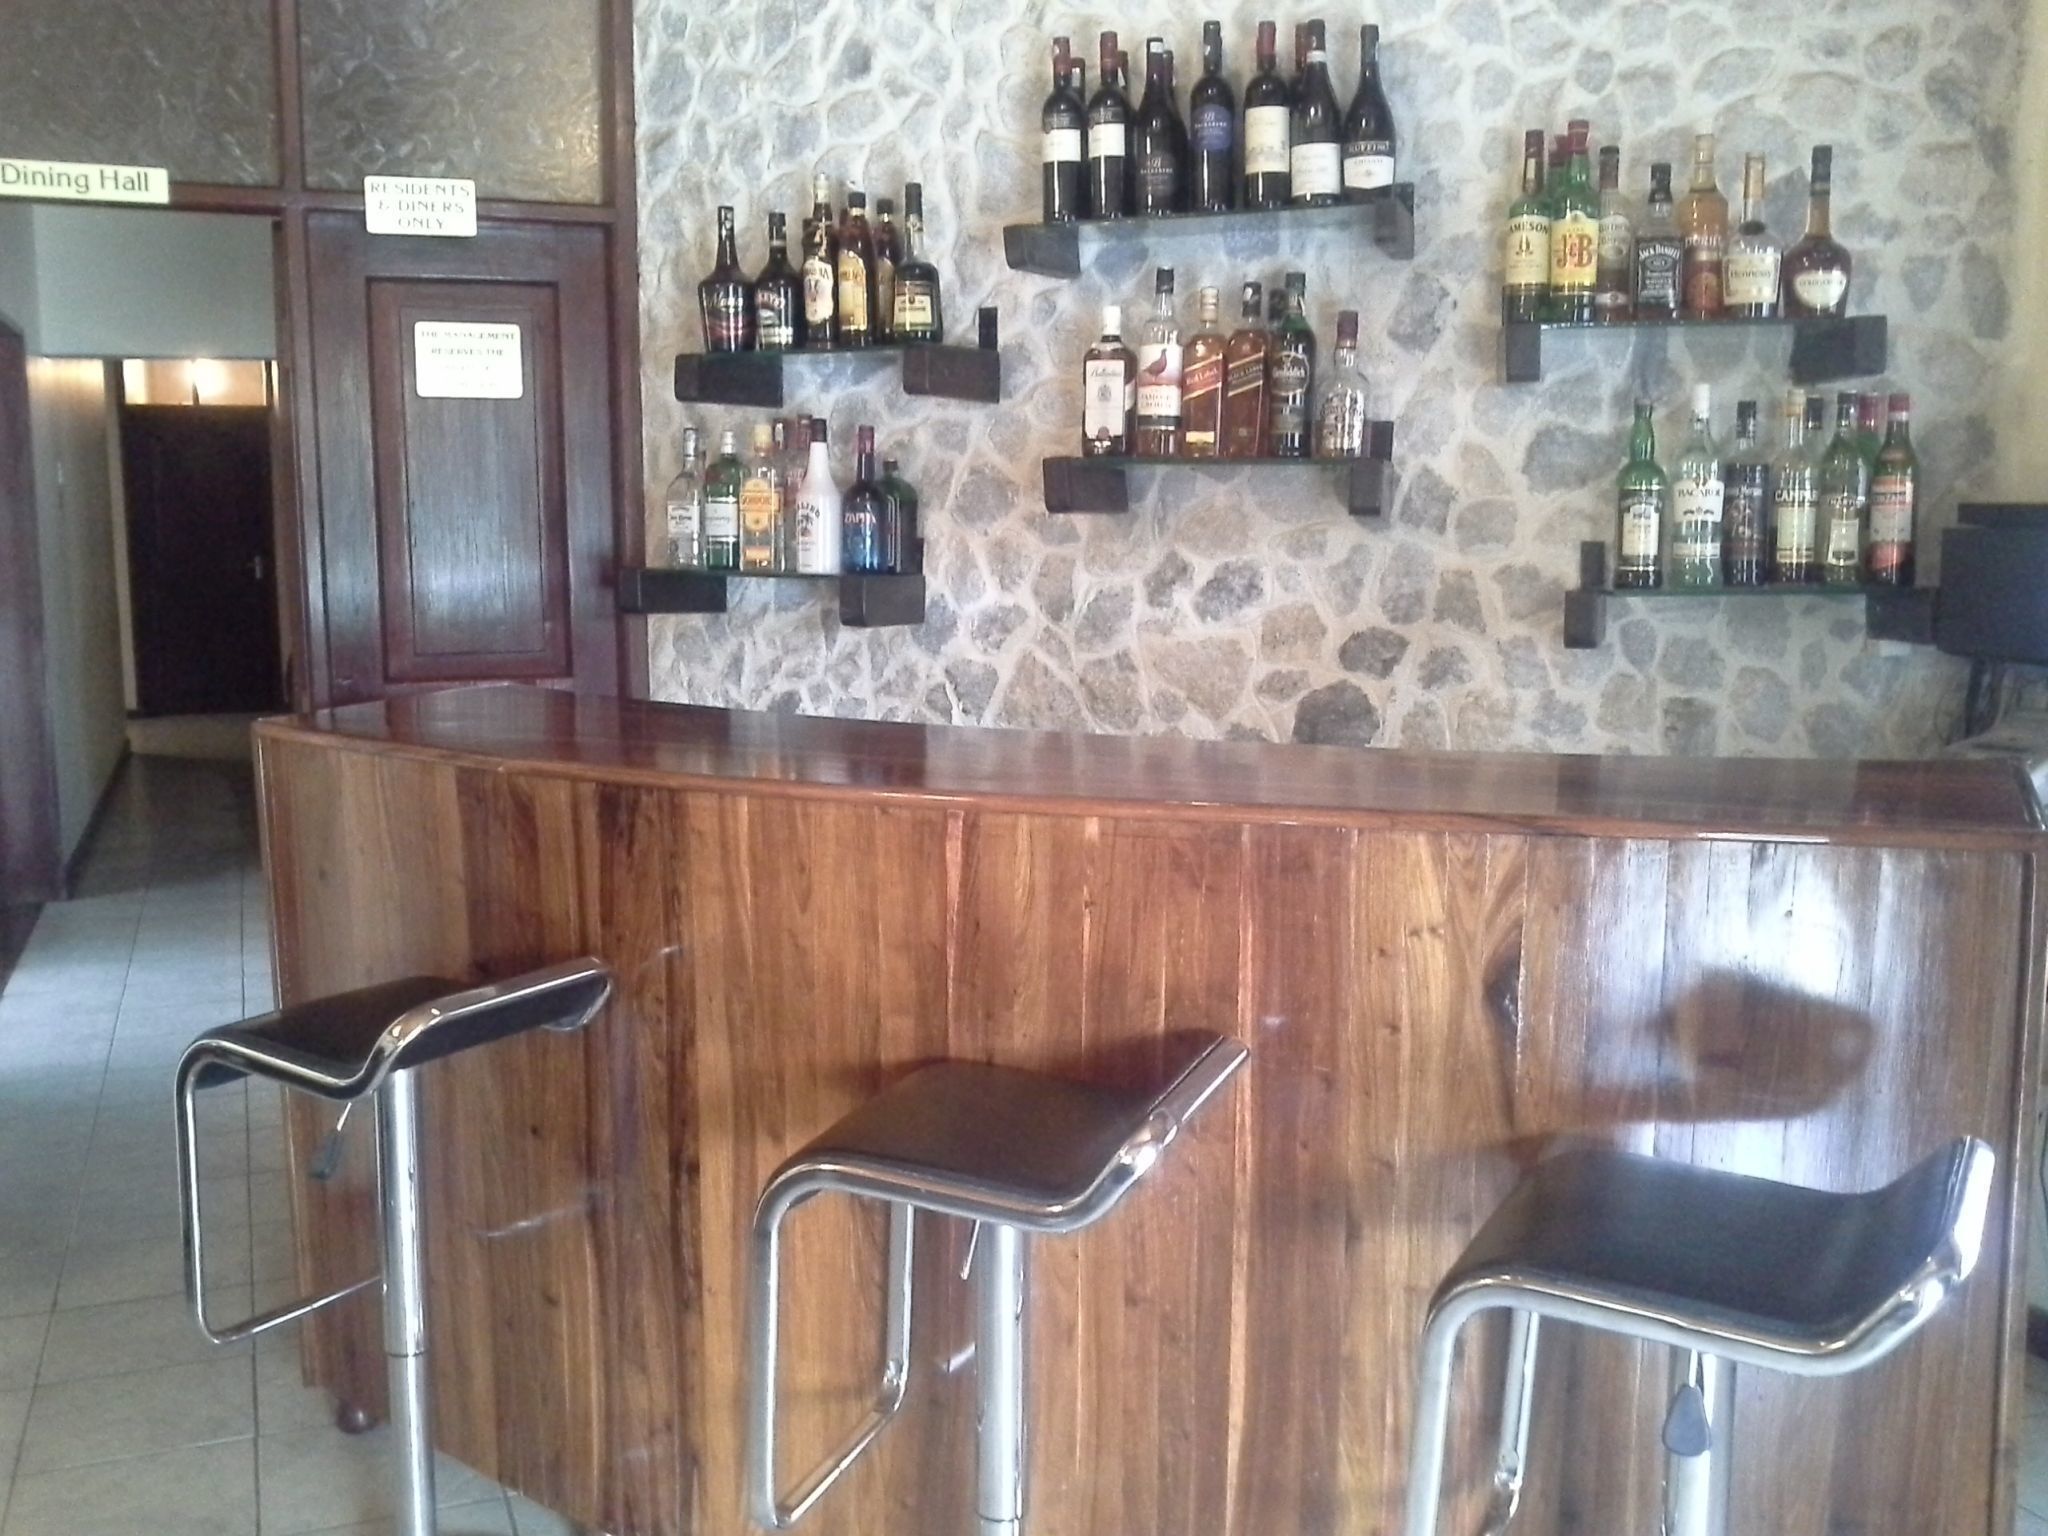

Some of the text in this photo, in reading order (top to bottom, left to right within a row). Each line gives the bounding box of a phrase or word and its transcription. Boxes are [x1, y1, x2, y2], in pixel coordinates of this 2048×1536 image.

[1, 162, 149, 194] Dining Hall
[370, 182, 470, 196] RESIDENTS
[399, 200, 464, 213] DINERS
[398, 217, 443, 229] ONLY
